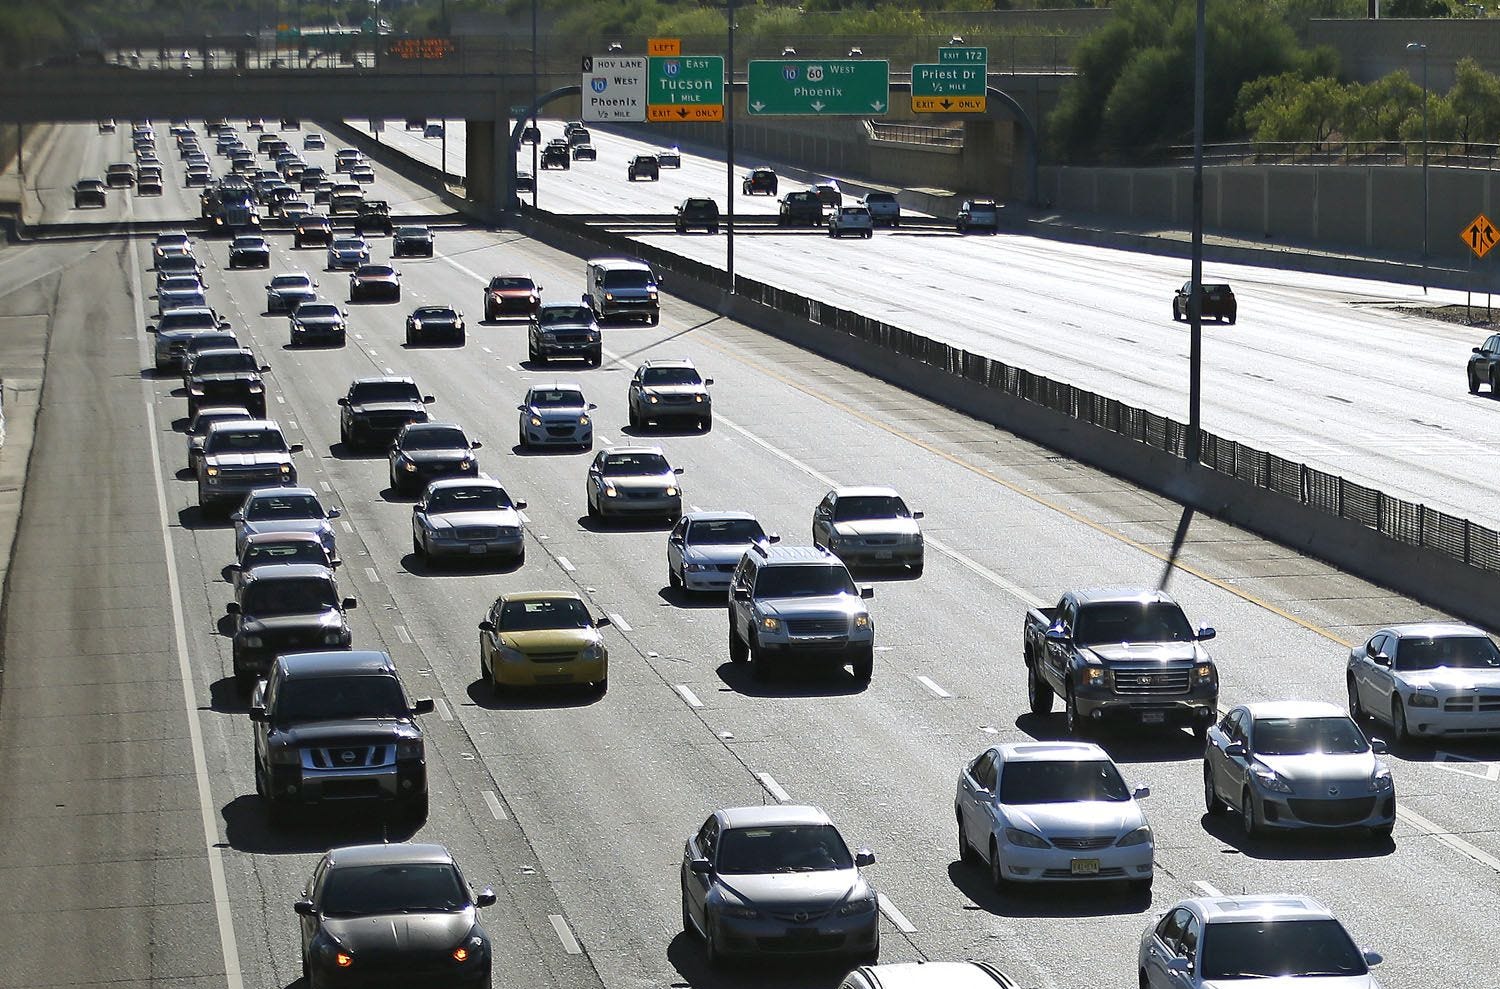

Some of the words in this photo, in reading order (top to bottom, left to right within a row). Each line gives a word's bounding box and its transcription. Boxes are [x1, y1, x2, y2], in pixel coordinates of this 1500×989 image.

[966, 52, 982, 60] 172
[598, 61, 616, 69] HOV
[620, 61, 643, 69] LANE
[667, 64, 677, 74] 10
[686, 60, 709, 69] EAST
[786, 70, 796, 80] 10
[809, 69, 822, 79] 60
[829, 64, 856, 74] WEST
[922, 69, 957, 79] Priest
[963, 70, 976, 79] Dr
[594, 80, 604, 91] 10
[614, 77, 639, 86] WEST
[660, 79, 713, 90] Tucson
[949, 83, 966, 91] MILE
[793, 87, 842, 97] Phoenix
[591, 97, 637, 107] Phoenix
[681, 94, 701, 102] MILE
[959, 101, 981, 109] ONLY
[653, 110, 671, 118] EXIT
[695, 110, 719, 118] ONLY
